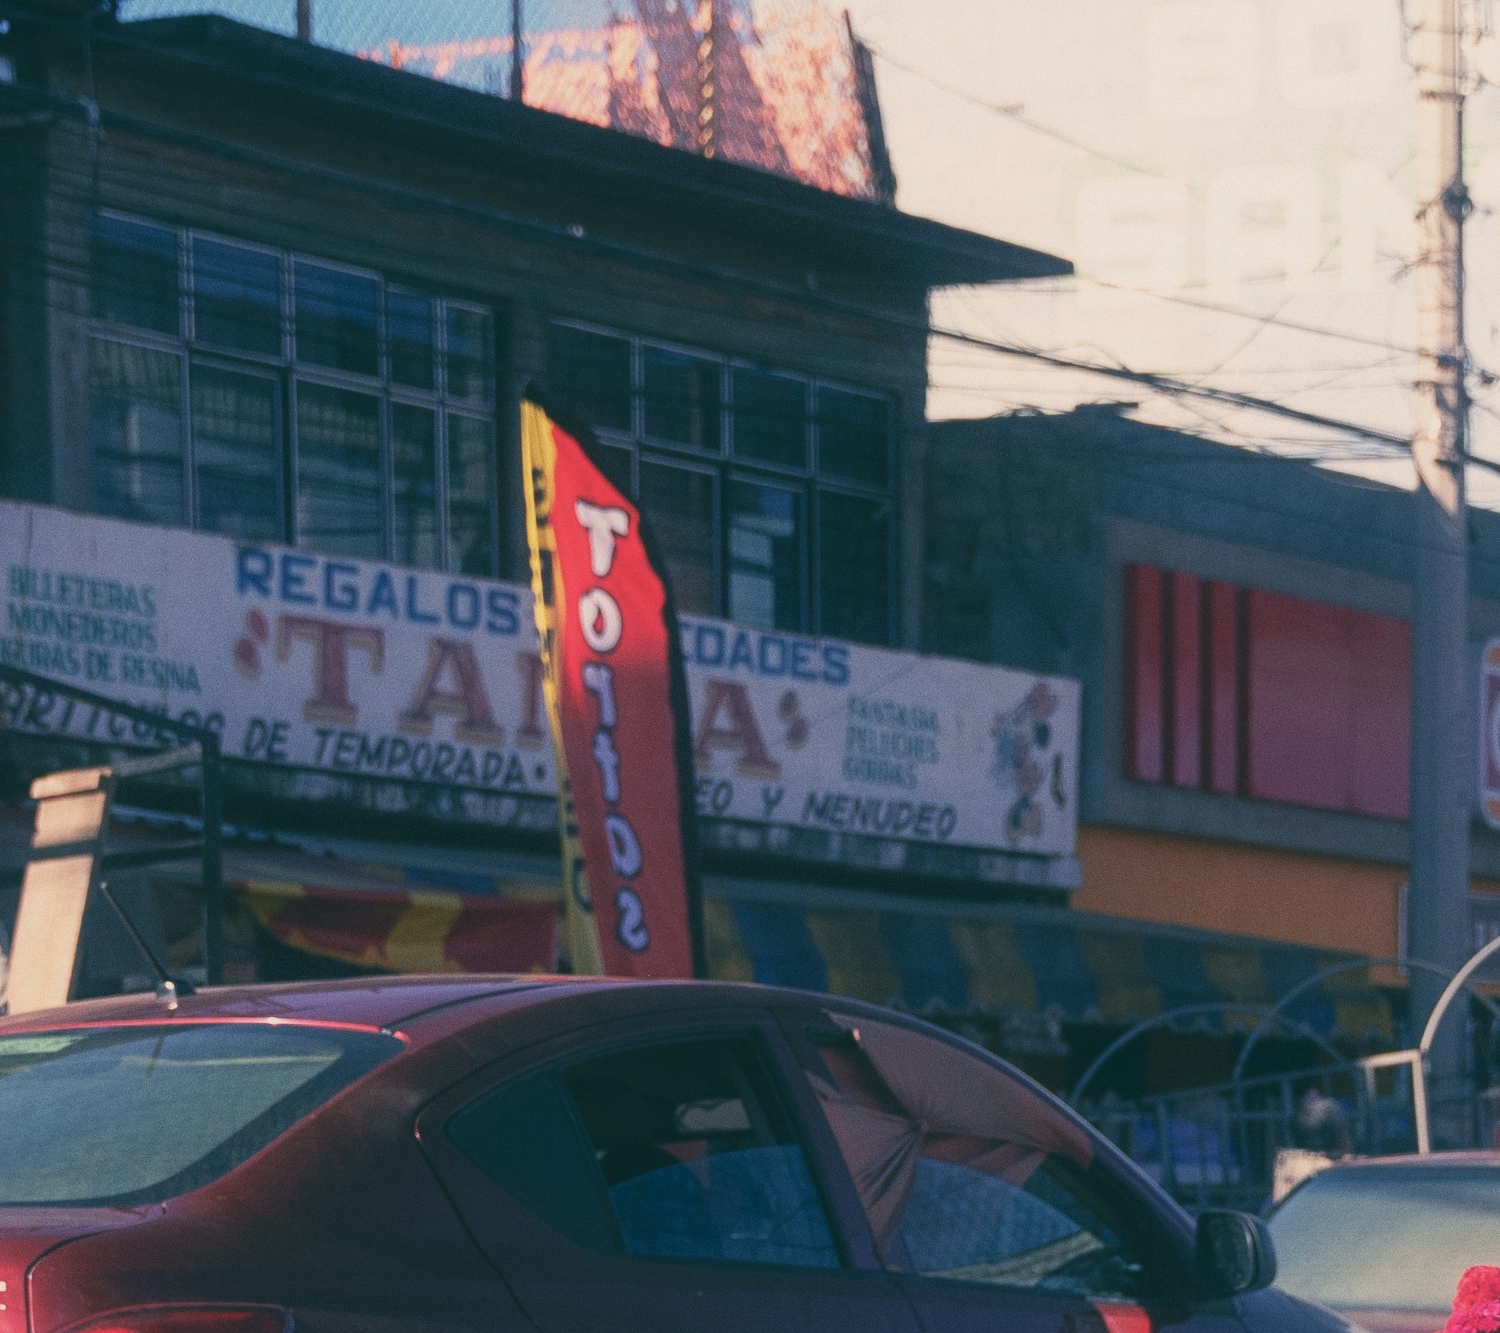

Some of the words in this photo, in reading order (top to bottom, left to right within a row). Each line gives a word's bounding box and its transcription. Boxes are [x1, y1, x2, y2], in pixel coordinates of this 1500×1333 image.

[9, 564, 156, 618] BILLETERAS
[234, 549, 522, 637] REGALOS
[7, 601, 157, 652] MONEDEROS
[85, 648, 116, 682] DE
[119, 655, 201, 694] RESINA
[245, 714, 290, 763] DE
[313, 729, 527, 786] TEMPORADA
[761, 785, 785, 820] Y
[803, 790, 959, 840] MENUDEO
